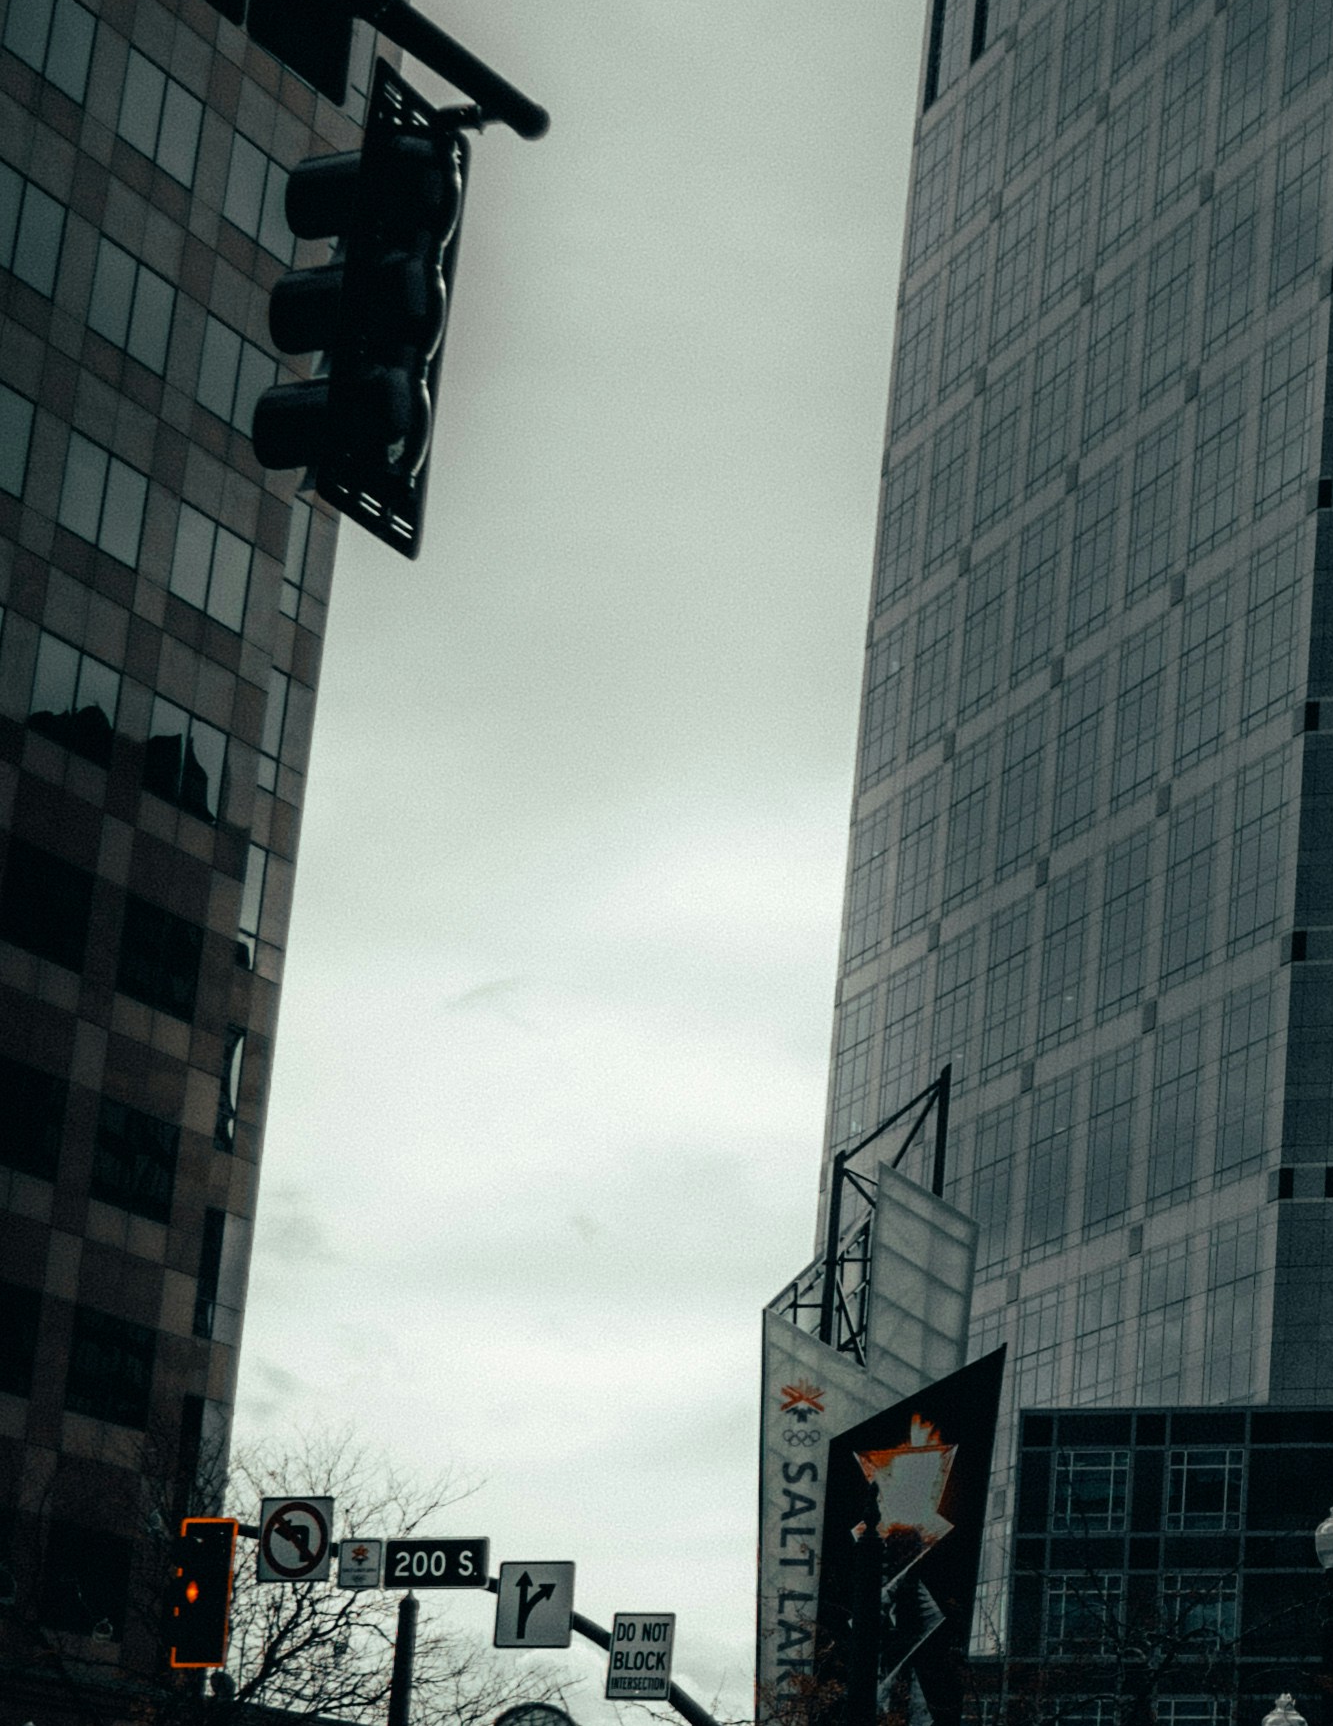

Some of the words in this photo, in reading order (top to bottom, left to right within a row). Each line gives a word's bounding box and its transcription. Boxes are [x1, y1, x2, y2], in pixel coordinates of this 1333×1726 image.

[780, 1462, 818, 1576] SALT
[394, 1550, 447, 1577] 200
[457, 1549, 478, 1577] S.
[616, 1623, 636, 1642] DO
[641, 1623, 670, 1642] NOT
[777, 1590, 814, 1703] LAK
[613, 1651, 667, 1670] BLOCK
[611, 1677, 665, 1690] INTERSECTION
